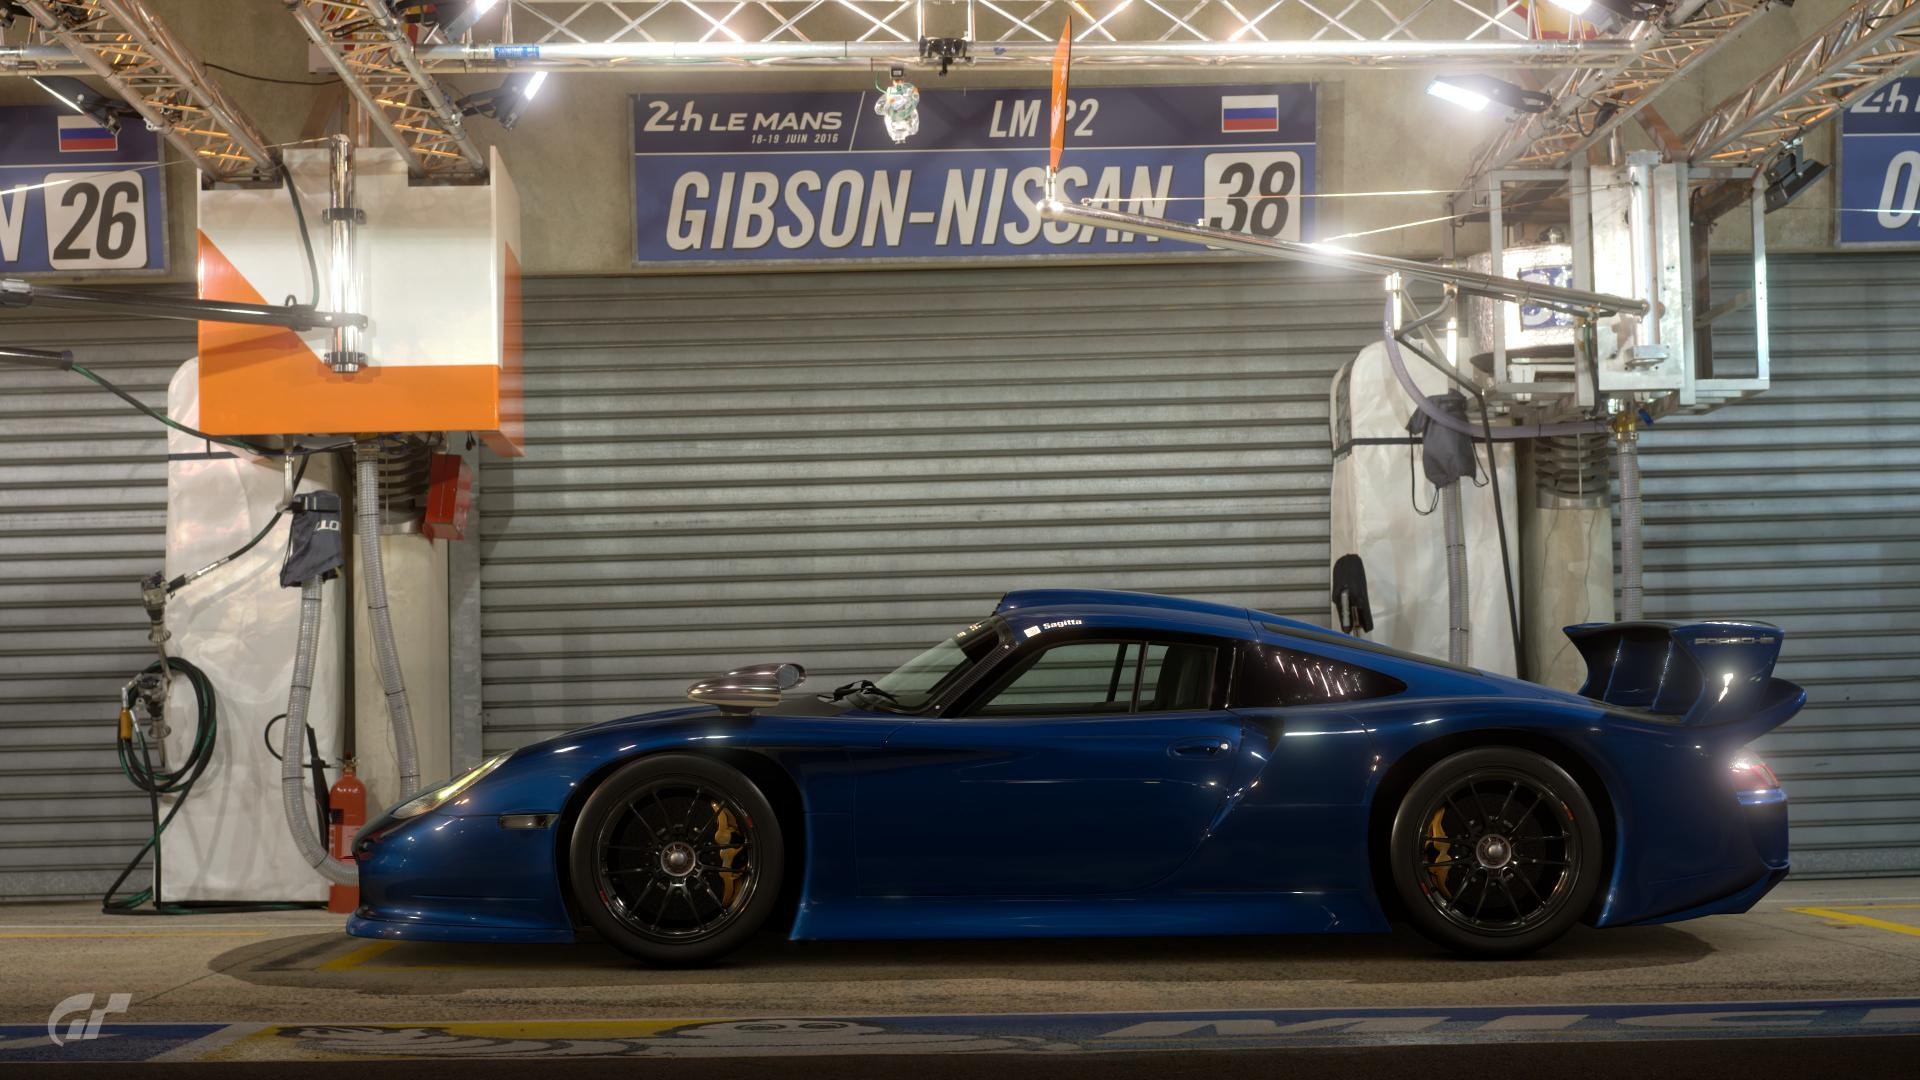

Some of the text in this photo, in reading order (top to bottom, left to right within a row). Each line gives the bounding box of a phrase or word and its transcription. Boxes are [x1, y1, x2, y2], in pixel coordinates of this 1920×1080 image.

[643, 100, 842, 132] 24h LE MANS
[989, 99, 1042, 138] LM
[751, 133, 839, 144] 18-19 JUIN 2016
[665, 165, 1174, 252] GIBSON-NISSAN
[1210, 160, 1296, 243] 38
[53, 181, 140, 260] 26
[1043, 619, 1083, 630] Sagitta
[1098, 1008, 1920, 1038] MIC
